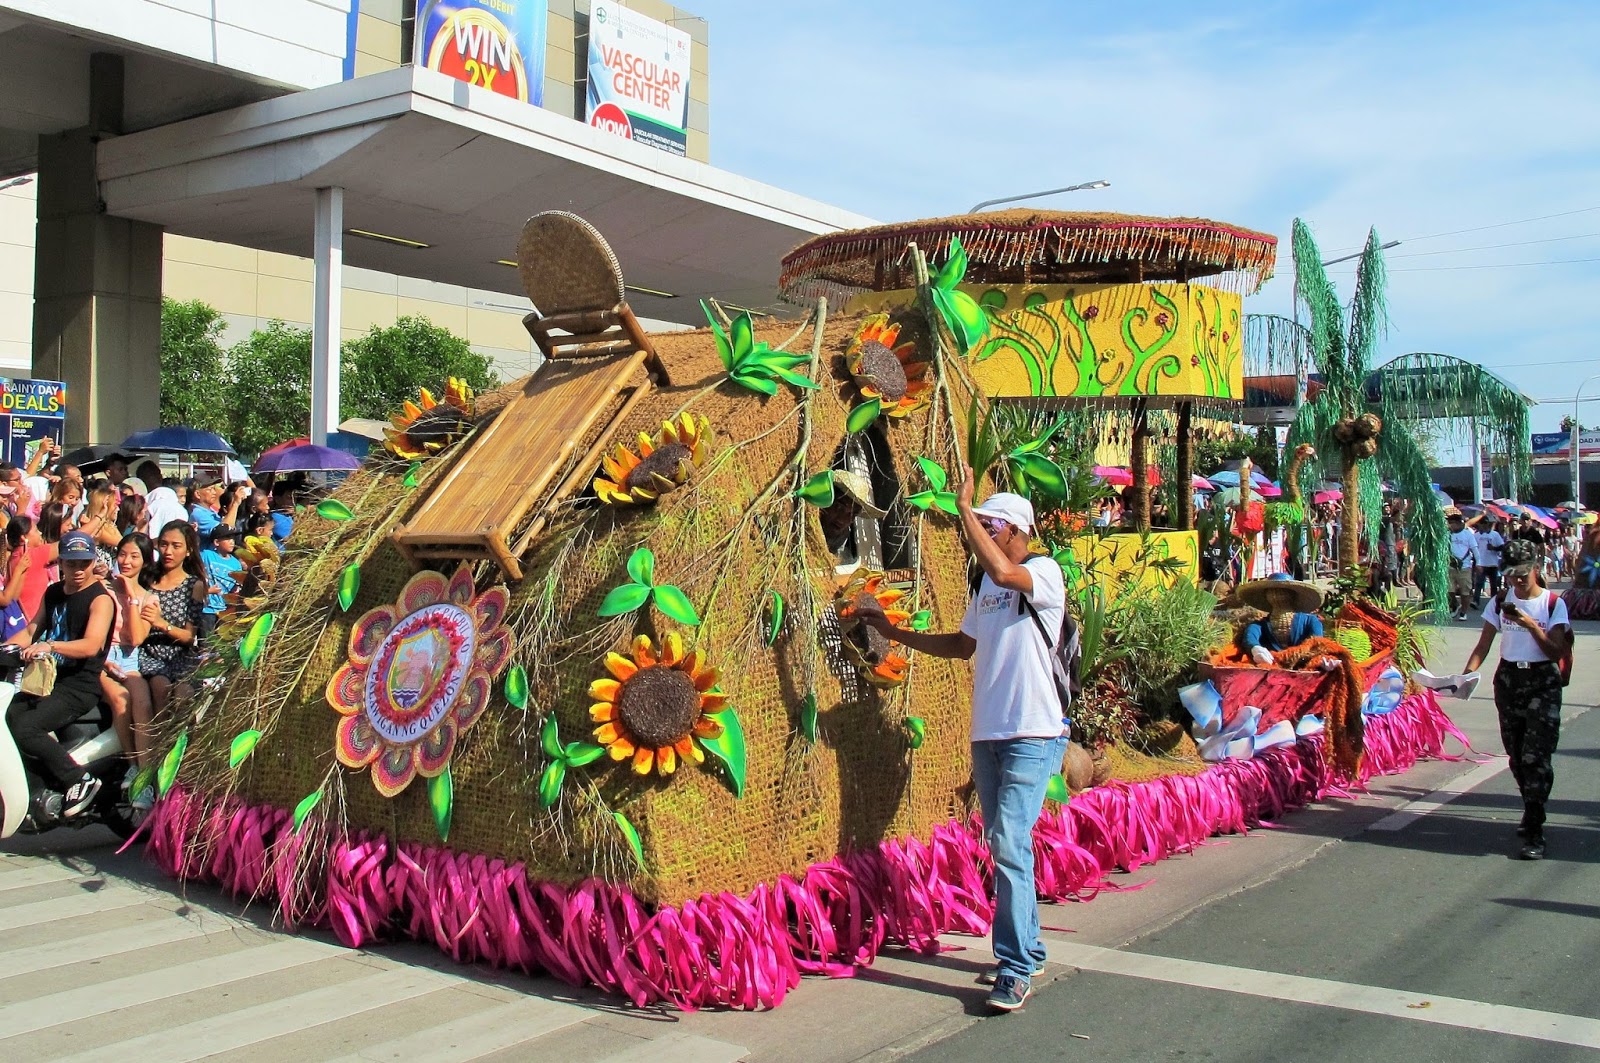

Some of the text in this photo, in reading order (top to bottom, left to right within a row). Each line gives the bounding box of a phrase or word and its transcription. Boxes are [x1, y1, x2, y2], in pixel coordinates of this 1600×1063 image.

[490, 0, 515, 15] DEBIT
[454, 15, 511, 72] WIN
[465, 59, 497, 90] 2X
[602, 44, 680, 93] VASCULAR
[613, 72, 670, 111] CENTER
[596, 116, 628, 137] NOW
[2, 393, 59, 412] DEALS
[3, 383, 59, 395] RAINY DAY
[402, 723, 416, 736] NG
[420, 675, 460, 730] QUEZON
